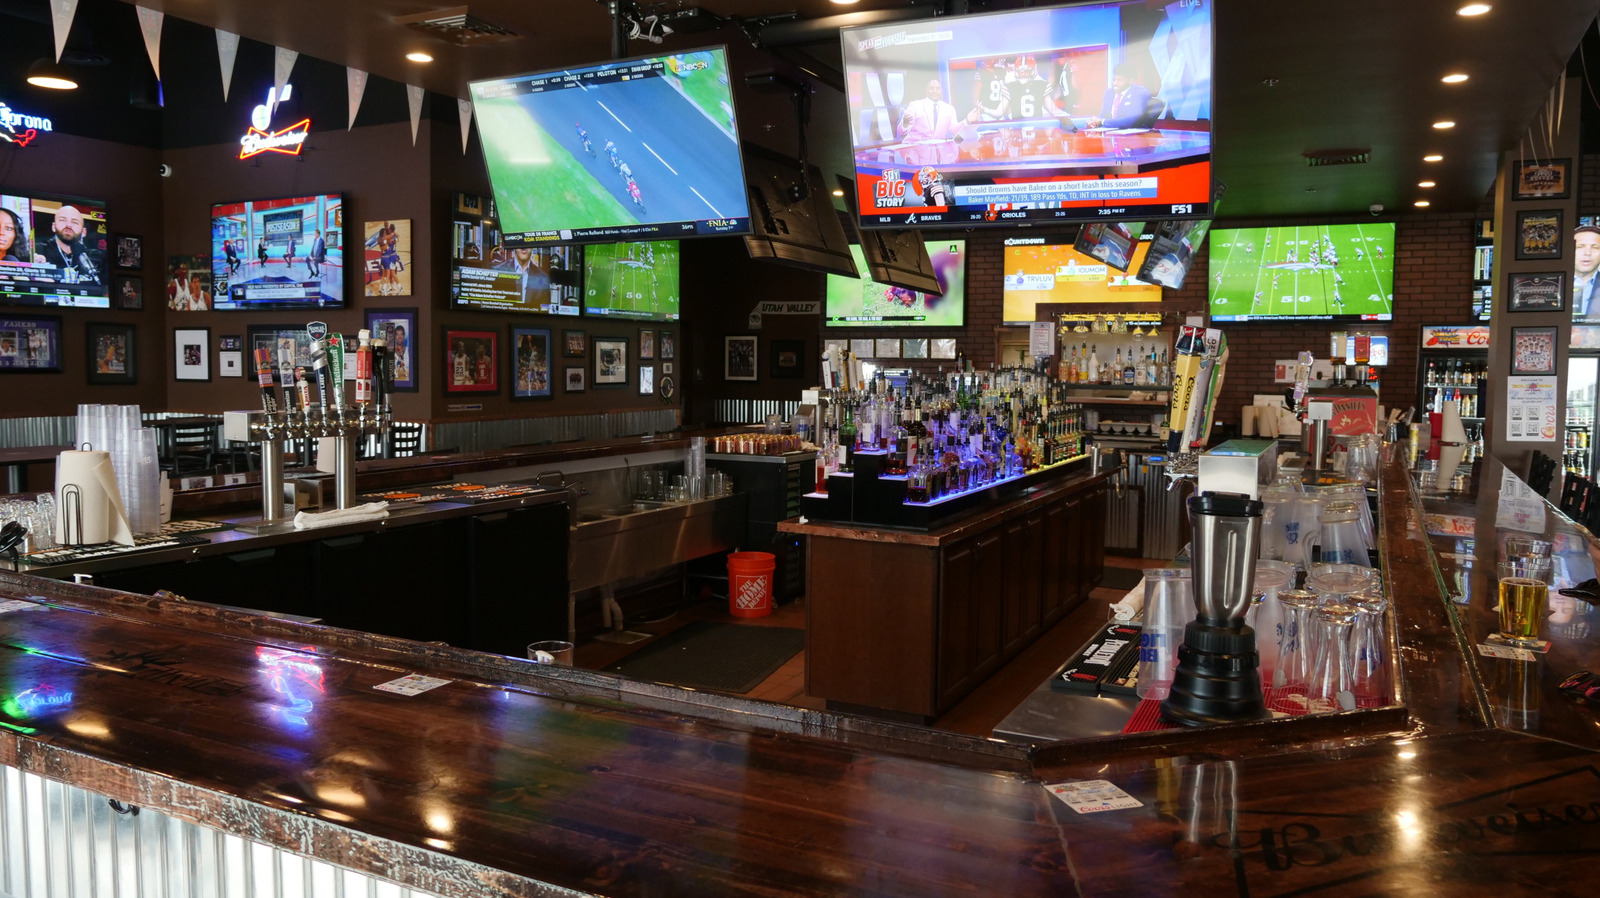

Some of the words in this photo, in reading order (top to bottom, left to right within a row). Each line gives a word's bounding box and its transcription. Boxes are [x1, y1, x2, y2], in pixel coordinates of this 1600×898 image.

[597, 69, 617, 77] PELOTON
[1020, 94, 1035, 118] 6
[876, 180, 905, 198] BIG
[966, 186, 987, 195] Should
[988, 185, 1011, 194] Browns
[1012, 184, 1027, 192] have
[1028, 184, 1047, 192] Baker
[1063, 182, 1080, 190] short
[1081, 181, 1099, 189] leash
[1115, 180, 1142, 188] season?
[876, 197, 905, 207] STORY
[985, 194, 1009, 204] Mayfield:
[1011, 194, 1029, 202] 21/39,
[1056, 192, 1068, 200] Yds,
[1080, 191, 1089, 199] INT
[1171, 204, 1193, 214] FS1
[1004, 238, 1045, 246] COUNTDOWN
[762, 303, 783, 312] UTAH
[786, 303, 816, 312] VALLEY
[330, 349, 342, 383] Heineken
[1184, 376, 1196, 411] Coors
[736, 575, 767, 609] HOME
[739, 579, 754, 593] THE
[748, 588, 767, 609] DEPOT
[1080, 805, 1111, 813] Coors
